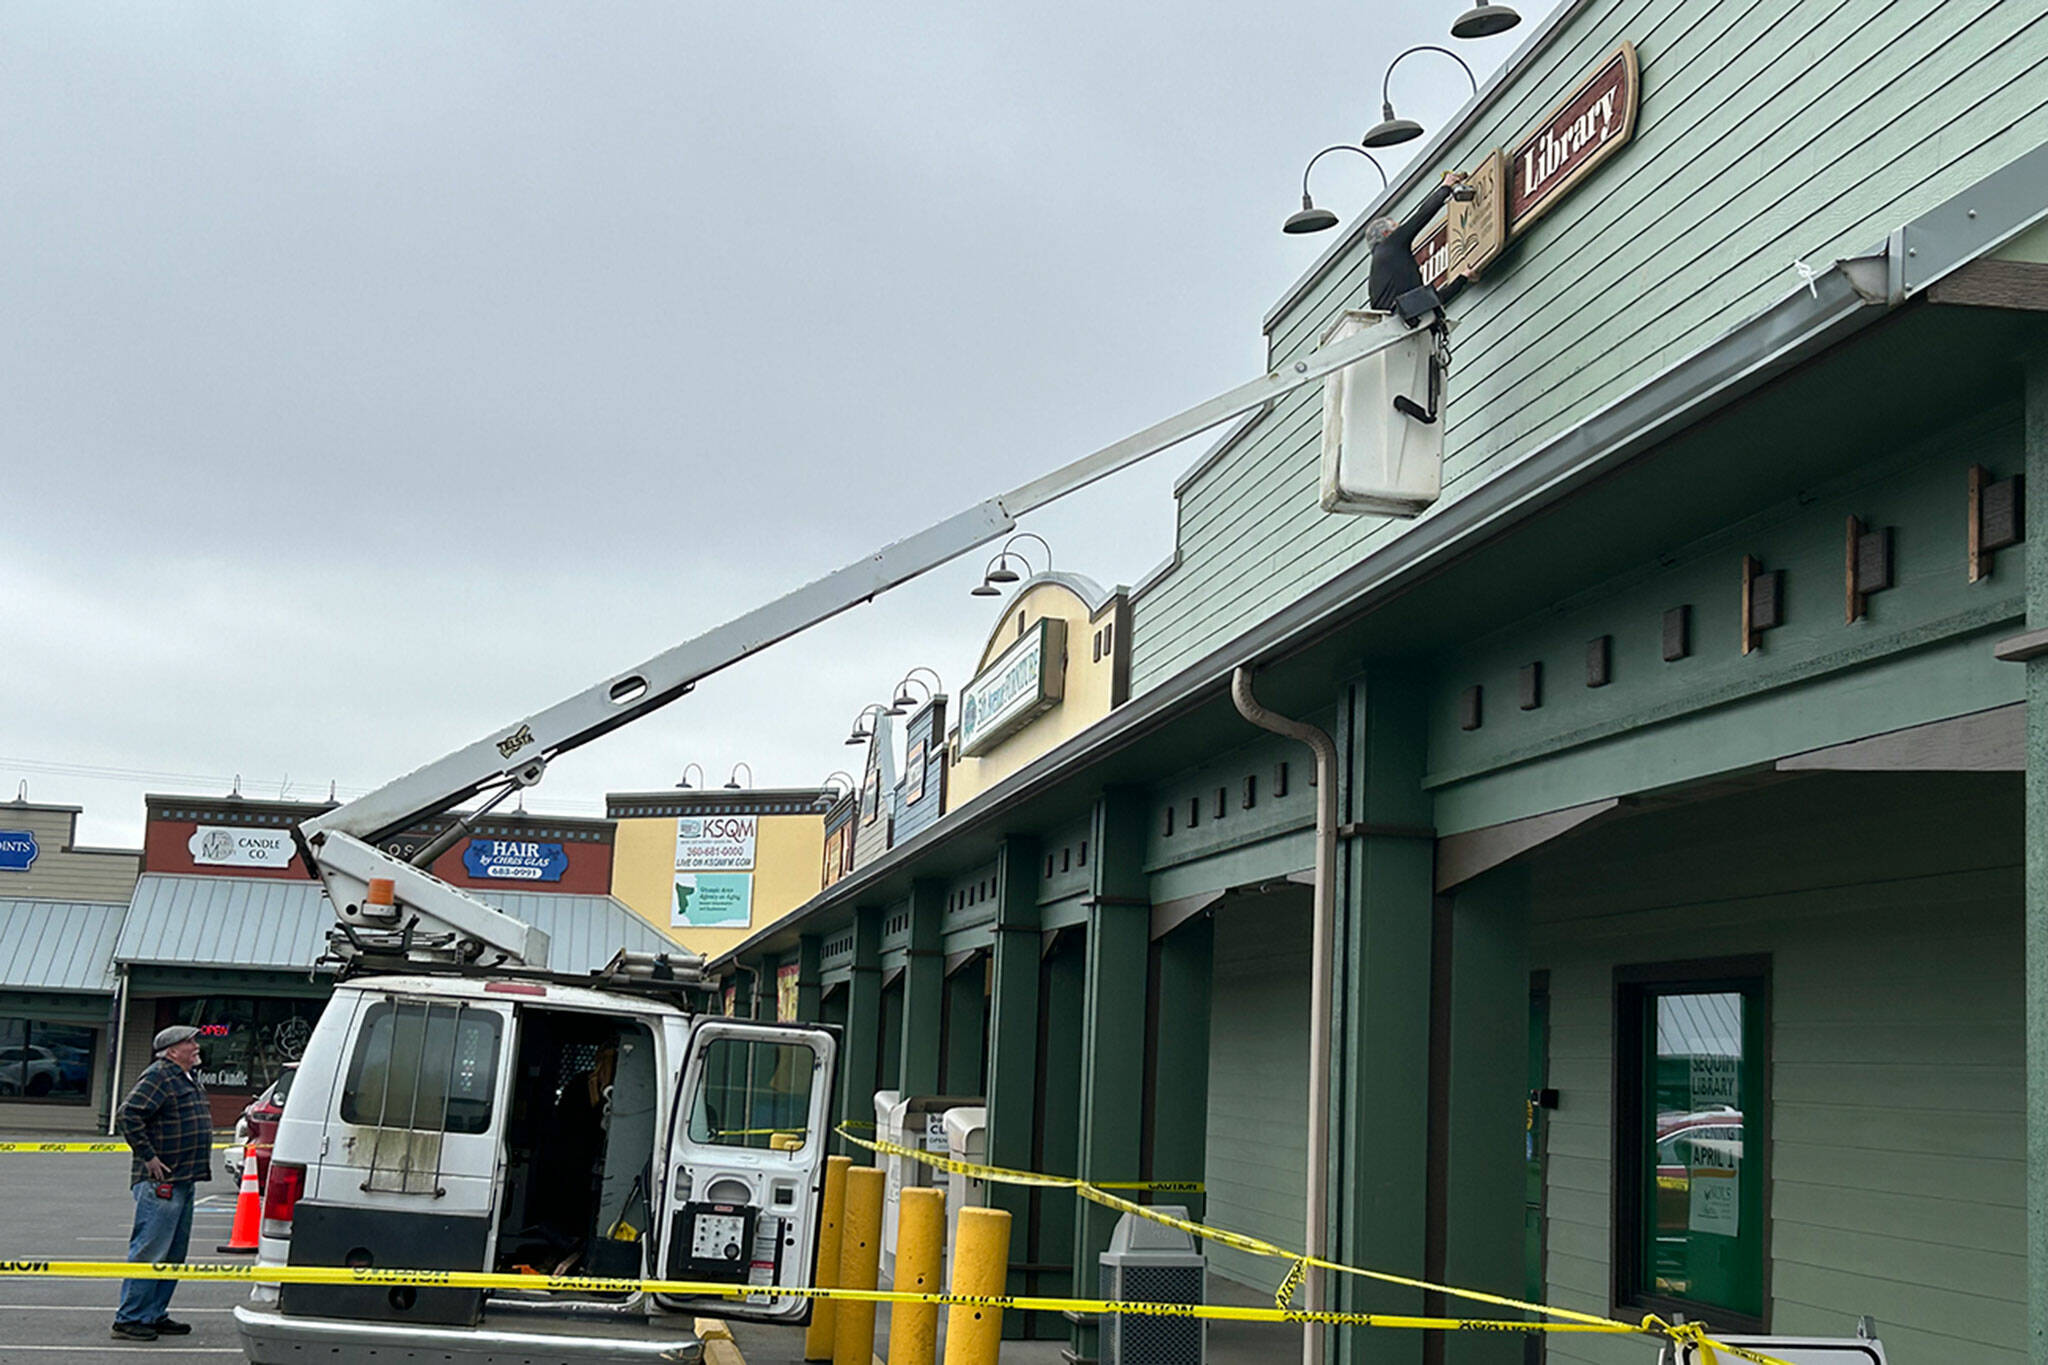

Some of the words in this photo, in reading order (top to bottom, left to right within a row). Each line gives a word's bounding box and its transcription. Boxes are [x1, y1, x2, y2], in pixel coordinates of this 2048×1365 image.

[1523, 84, 1620, 199] Library
[702, 818, 755, 843] KSQM
[238, 838, 280, 850] CANDLE
[492, 841, 540, 858] HAIR
[248, 849, 268, 860] CO.
[686, 846, 745, 857] 360-681-0000
[480, 855, 493, 867] by
[493, 855, 522, 866] CHRIS
[524, 857, 551, 868] GLAS
[675, 858, 692, 868] LIVE
[200, 1025, 229, 1037] OPEN
[1692, 1077, 1735, 1096] LIBRARY
[1693, 1145, 1723, 1168] APRIL
[1727, 1149, 1734, 1168] 1
